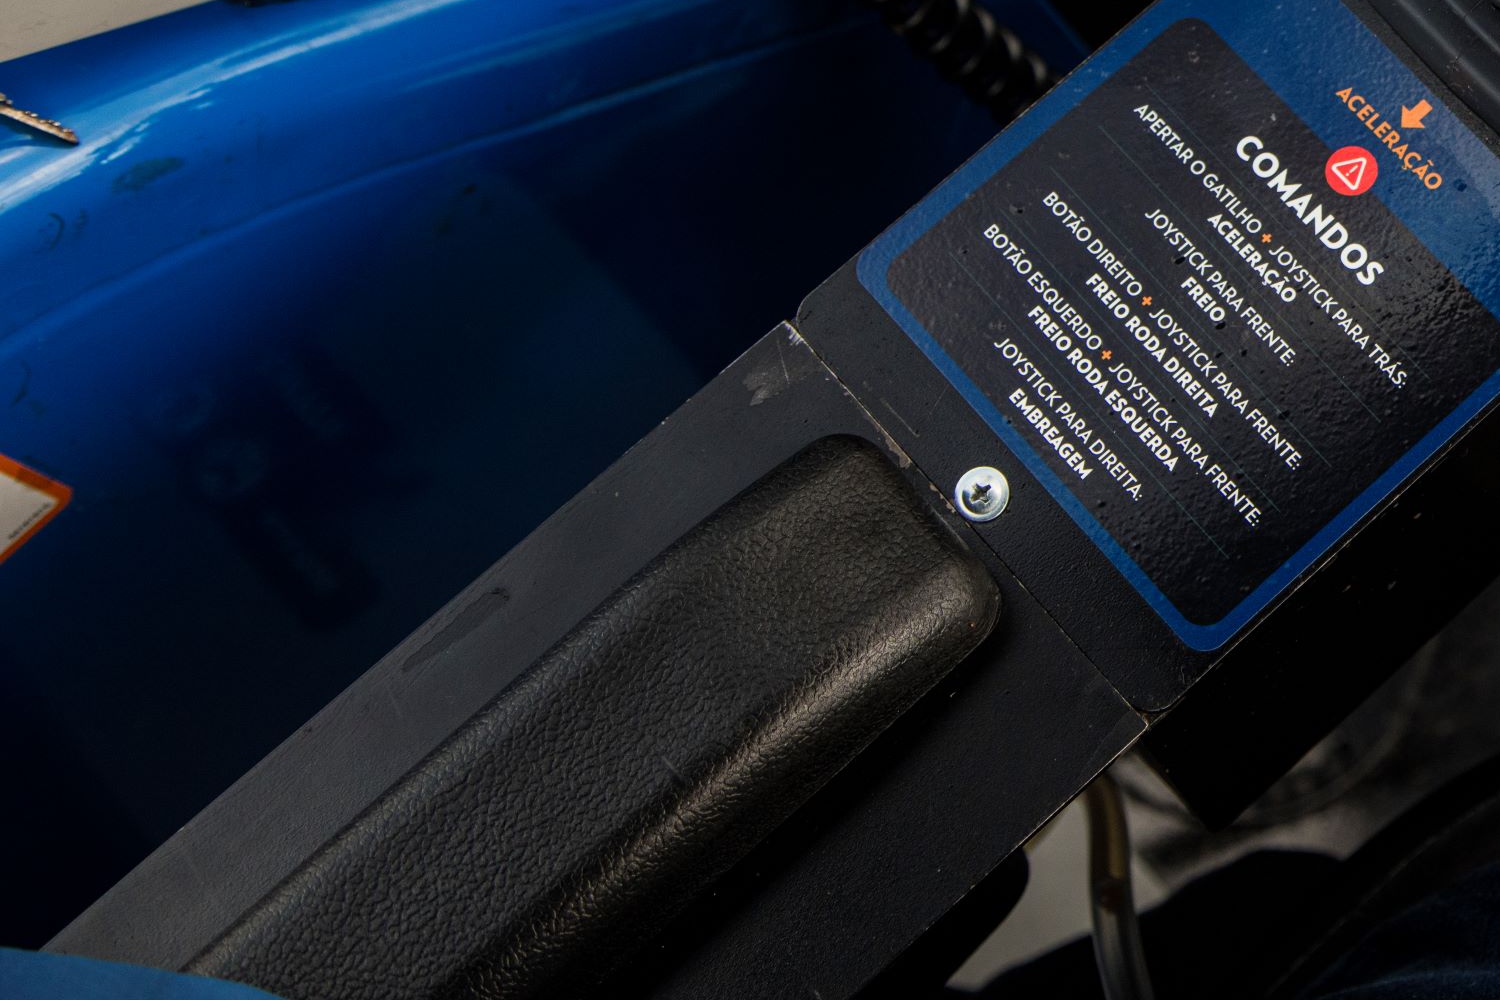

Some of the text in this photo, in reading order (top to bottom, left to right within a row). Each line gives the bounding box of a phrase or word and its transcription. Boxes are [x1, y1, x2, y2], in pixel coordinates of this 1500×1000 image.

[1236, 135, 1385, 286] COMANDOS
[1335, 86, 1444, 192] ACELERAÇÃO
[1133, 104, 1194, 165] APERTAR
[1190, 160, 1206, 176] O
[1202, 173, 1262, 234] GATILHO
[1269, 245, 1338, 314] JOYSTICK
[1332, 308, 1370, 350] PARA
[1368, 343, 1408, 389] TRÁS:
[1145, 209, 1297, 367] JOYSTICK PARA FRENTE:
[1181, 276, 1226, 323] FREIO
[1207, 213, 1297, 303] ACELERAÇÃO
[983, 223, 1032, 275] BOTÃO
[1026, 271, 1102, 351] ESQUERDO
[1108, 362, 1178, 432] JOYSTICK
[1171, 426, 1210, 470] PARA
[1205, 464, 1263, 527] FRENTE:
[1027, 305, 1180, 473] FREIO RODA ESQUERDA
[1042, 191, 1092, 243] BOTÃO
[1086, 238, 1143, 298] DIREITO
[1149, 308, 1218, 378] JOYSTICK
[1211, 371, 1249, 414] PARA
[1245, 408, 1302, 471] FRENTE:
[1086, 273, 1221, 418] FREIO RODA DIREITA
[994, 338, 1143, 502] JOYSTICK PARA DIREITA:
[1008, 388, 1094, 480] EMBREAGEM
